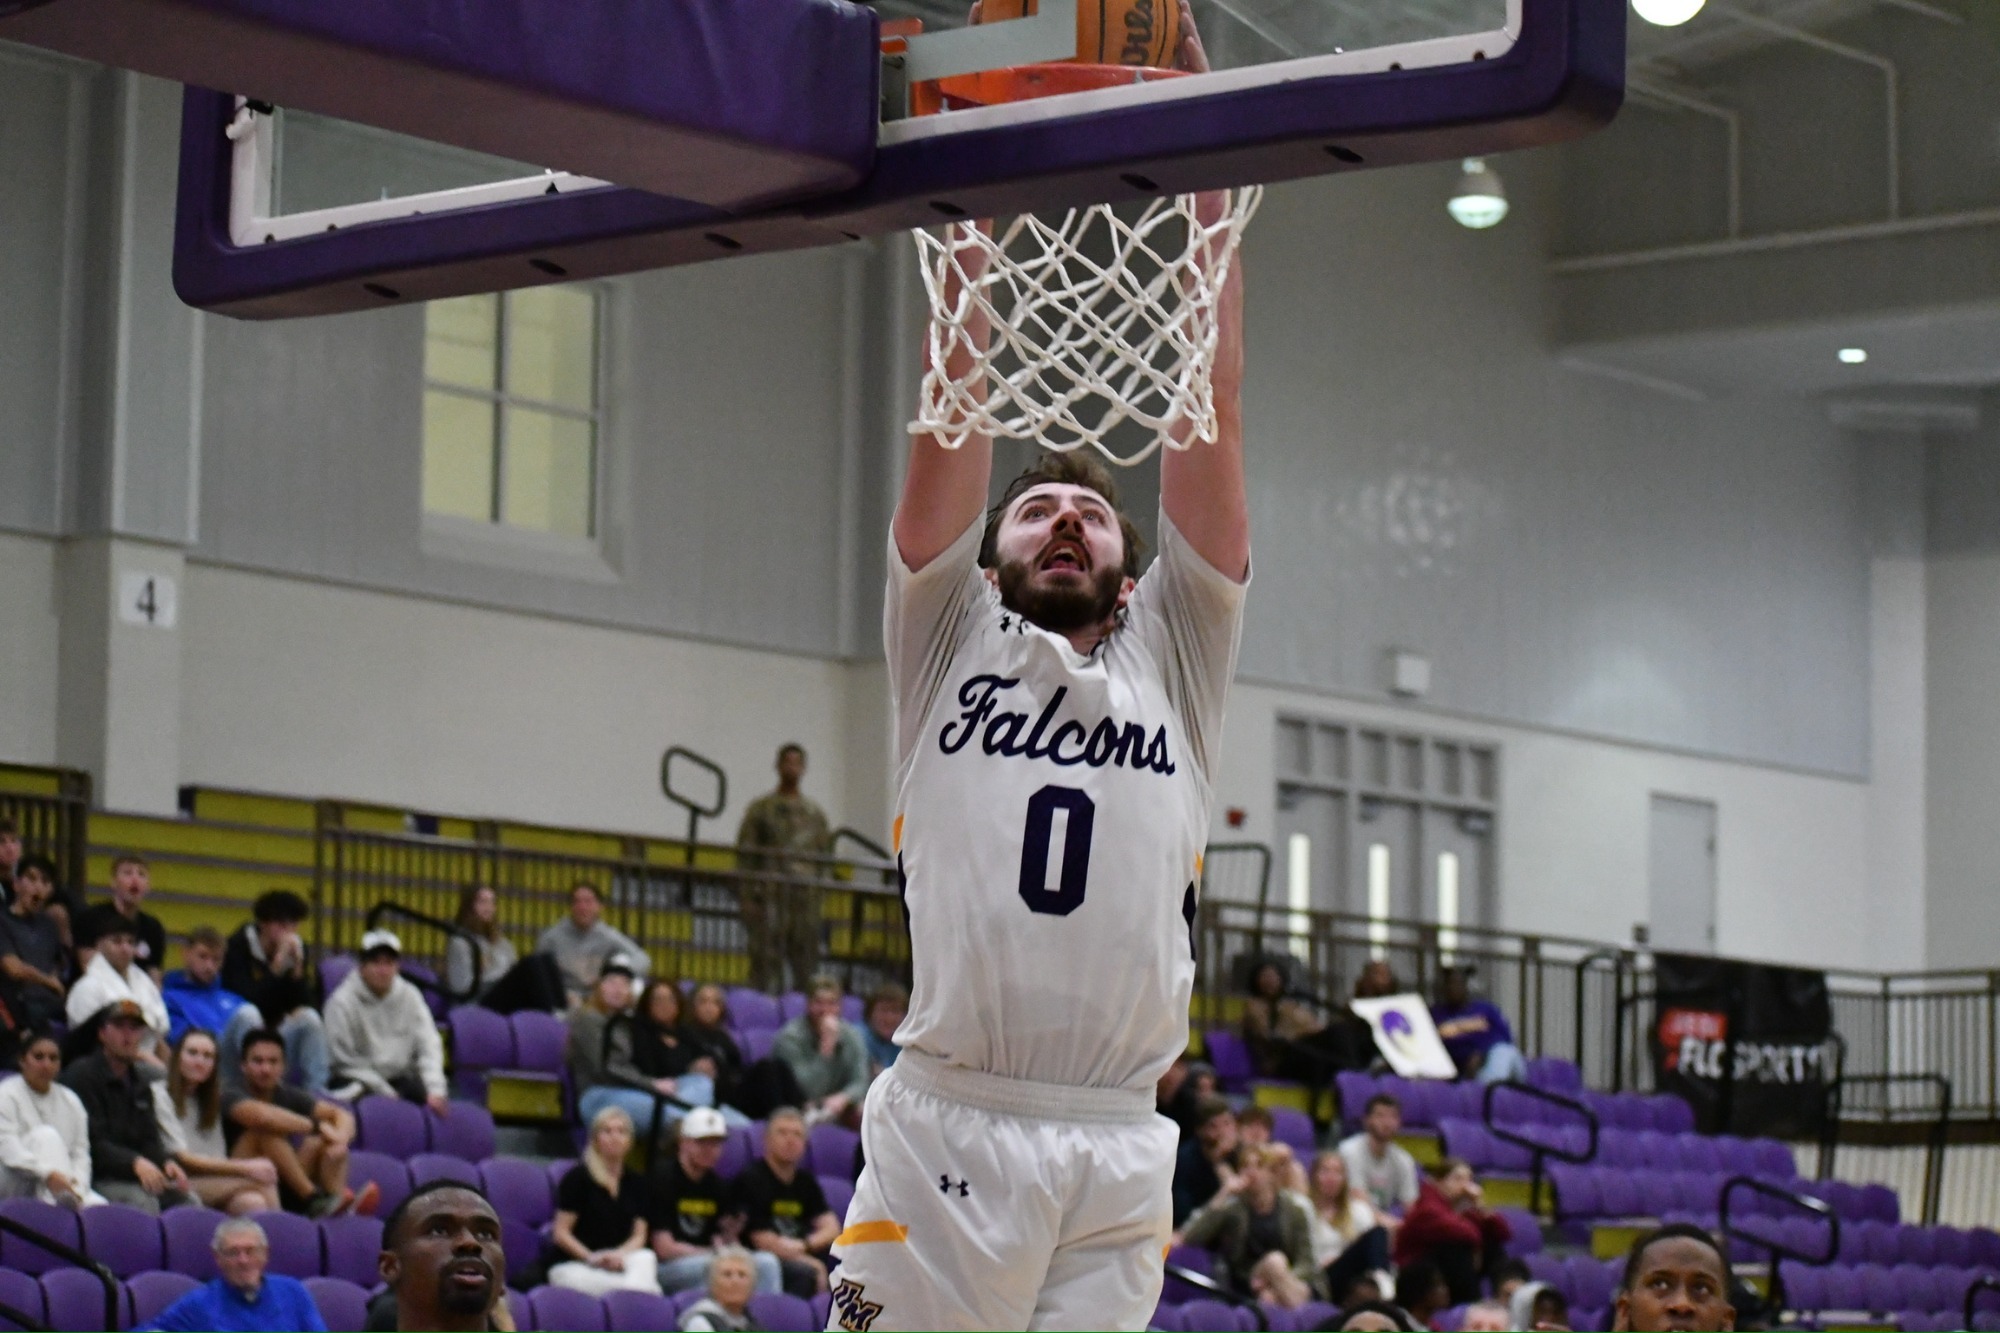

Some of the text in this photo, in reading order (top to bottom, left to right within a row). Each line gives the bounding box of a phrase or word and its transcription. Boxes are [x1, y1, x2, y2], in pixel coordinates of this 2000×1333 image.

[136, 579, 156, 622] 4
[939, 674, 1175, 776] Falcons
[1018, 784, 1096, 916] 0
